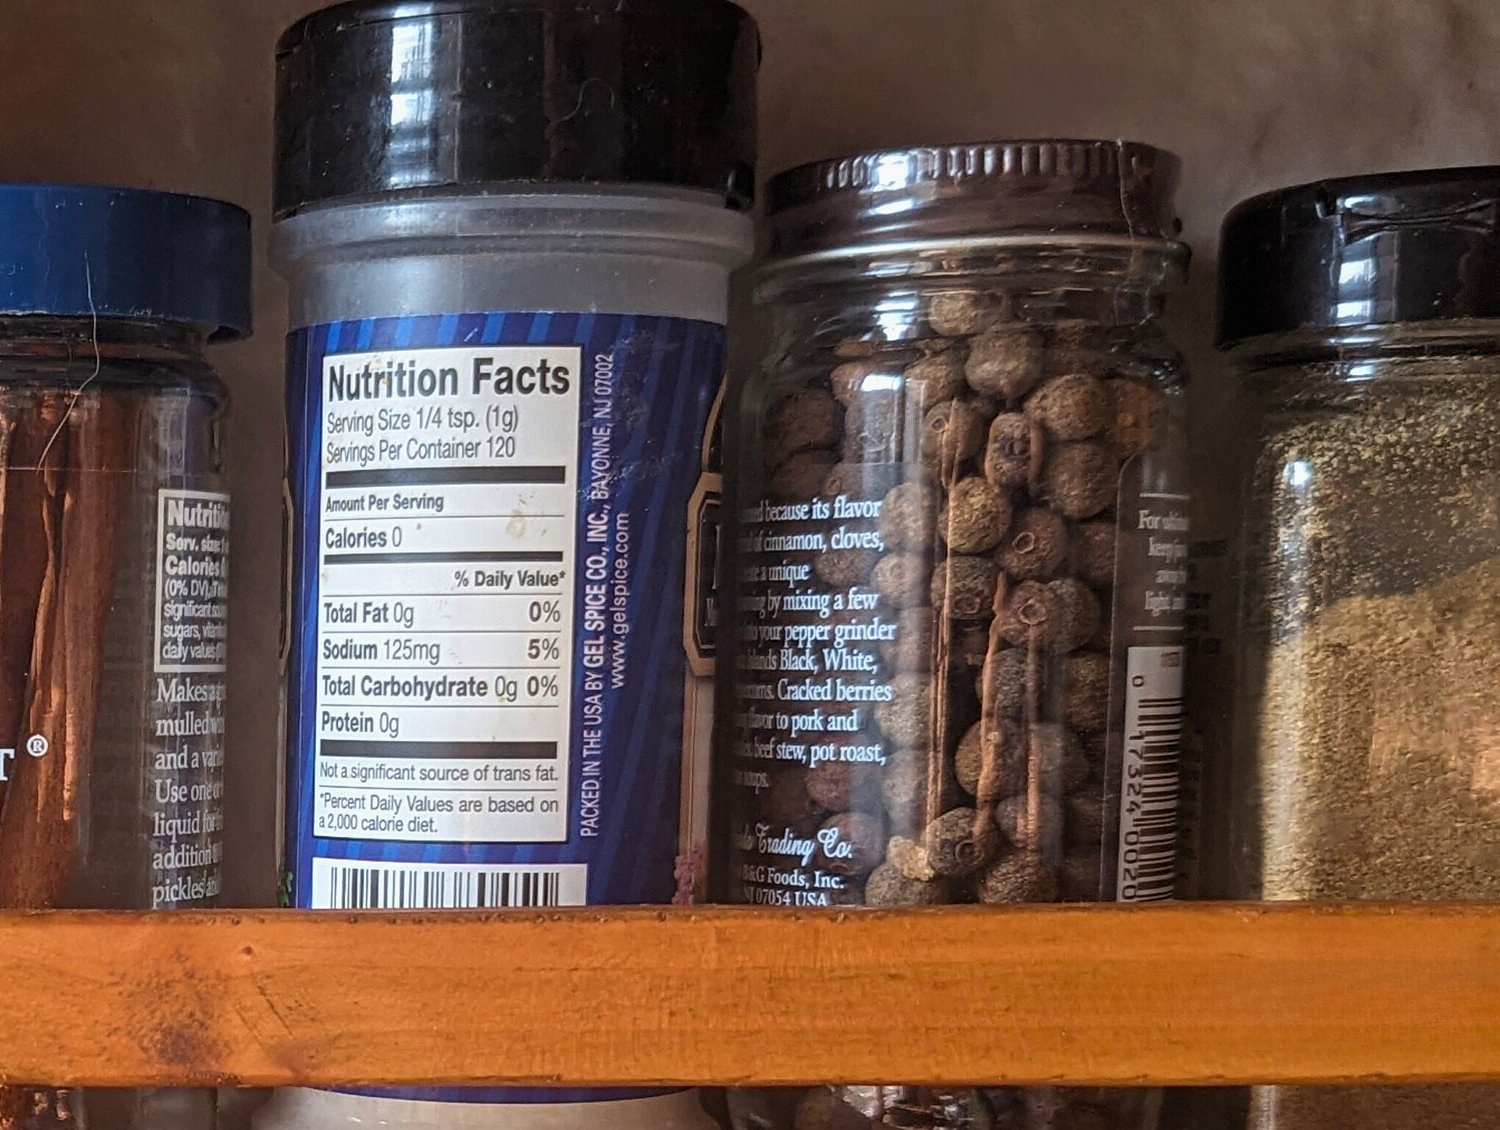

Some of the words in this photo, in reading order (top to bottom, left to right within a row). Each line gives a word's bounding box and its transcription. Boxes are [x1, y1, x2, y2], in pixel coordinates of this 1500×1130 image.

[329, 360, 458, 401] Nutrition
[472, 358, 570, 394] Facts
[595, 353, 614, 394] 07002
[327, 412, 373, 437] Serving
[378, 409, 410, 431] Size
[417, 406, 442, 429] 1/4
[448, 408, 480, 434] tsp.
[486, 405, 518, 432] (1g)
[327, 441, 375, 466] Servings
[379, 439, 402, 460] Per
[407, 438, 481, 458] Container
[487, 436, 515, 458] 120
[326, 496, 364, 513] Amount
[368, 496, 390, 510] Per
[393, 495, 443, 512] Serving
[812, 497, 829, 519] its
[833, 495, 882, 518] flavor
[326, 527, 387, 548] Calories
[764, 532, 827, 553] cinnamon,
[831, 526, 884, 551] cloves,
[165, 555, 220, 576] Calories
[769, 560, 809, 588] unique
[475, 571, 513, 590] Daily
[585, 584, 606, 631] SPICE
[609, 511, 630, 689] www.gelspice.com
[783, 589, 830, 618] mixing
[848, 587, 880, 610] few
[324, 603, 357, 623] Total
[363, 603, 389, 623] Fat
[394, 602, 414, 628] 0g
[529, 601, 561, 623] 0%
[784, 624, 830, 648] pepper
[835, 617, 897, 648] grinder
[323, 639, 377, 660] Sodium
[384, 639, 440, 665] 125mg
[528, 638, 559, 660] 5%
[584, 636, 605, 668] GEL
[780, 649, 818, 674] Black,
[823, 649, 878, 674] White,
[157, 678, 207, 703] Makes
[323, 675, 355, 696] Total
[361, 675, 488, 701] Carbohydrate
[495, 676, 517, 702] 0g
[527, 675, 558, 697] 0%
[778, 679, 831, 700] Cracked
[836, 679, 892, 700] berries
[156, 711, 209, 736] mulled
[584, 696, 603, 724] USA
[791, 709, 824, 738] pork
[827, 709, 859, 731] and
[322, 711, 374, 733] Protein
[380, 712, 399, 738] 0g
[583, 730, 600, 757] THE
[810, 743, 836, 768] pot
[840, 743, 886, 765] roast,
[155, 745, 188, 770] and
[155, 779, 187, 803] Use
[371, 795, 401, 815] Daily
[407, 795, 453, 812] Values
[459, 799, 482, 812] are
[488, 797, 534, 813] based
[540, 800, 558, 813] on
[581, 778, 600, 837] PACKED
[153, 811, 200, 843] liquid
[328, 814, 357, 831] 2,000
[361, 815, 403, 831] calorie
[408, 817, 438, 833] diet.
[768, 867, 809, 889] Foods,
[814, 871, 844, 888] Inc.
[152, 877, 203, 910] pickles
[756, 889, 790, 906] 07054
[795, 891, 828, 907] USA
